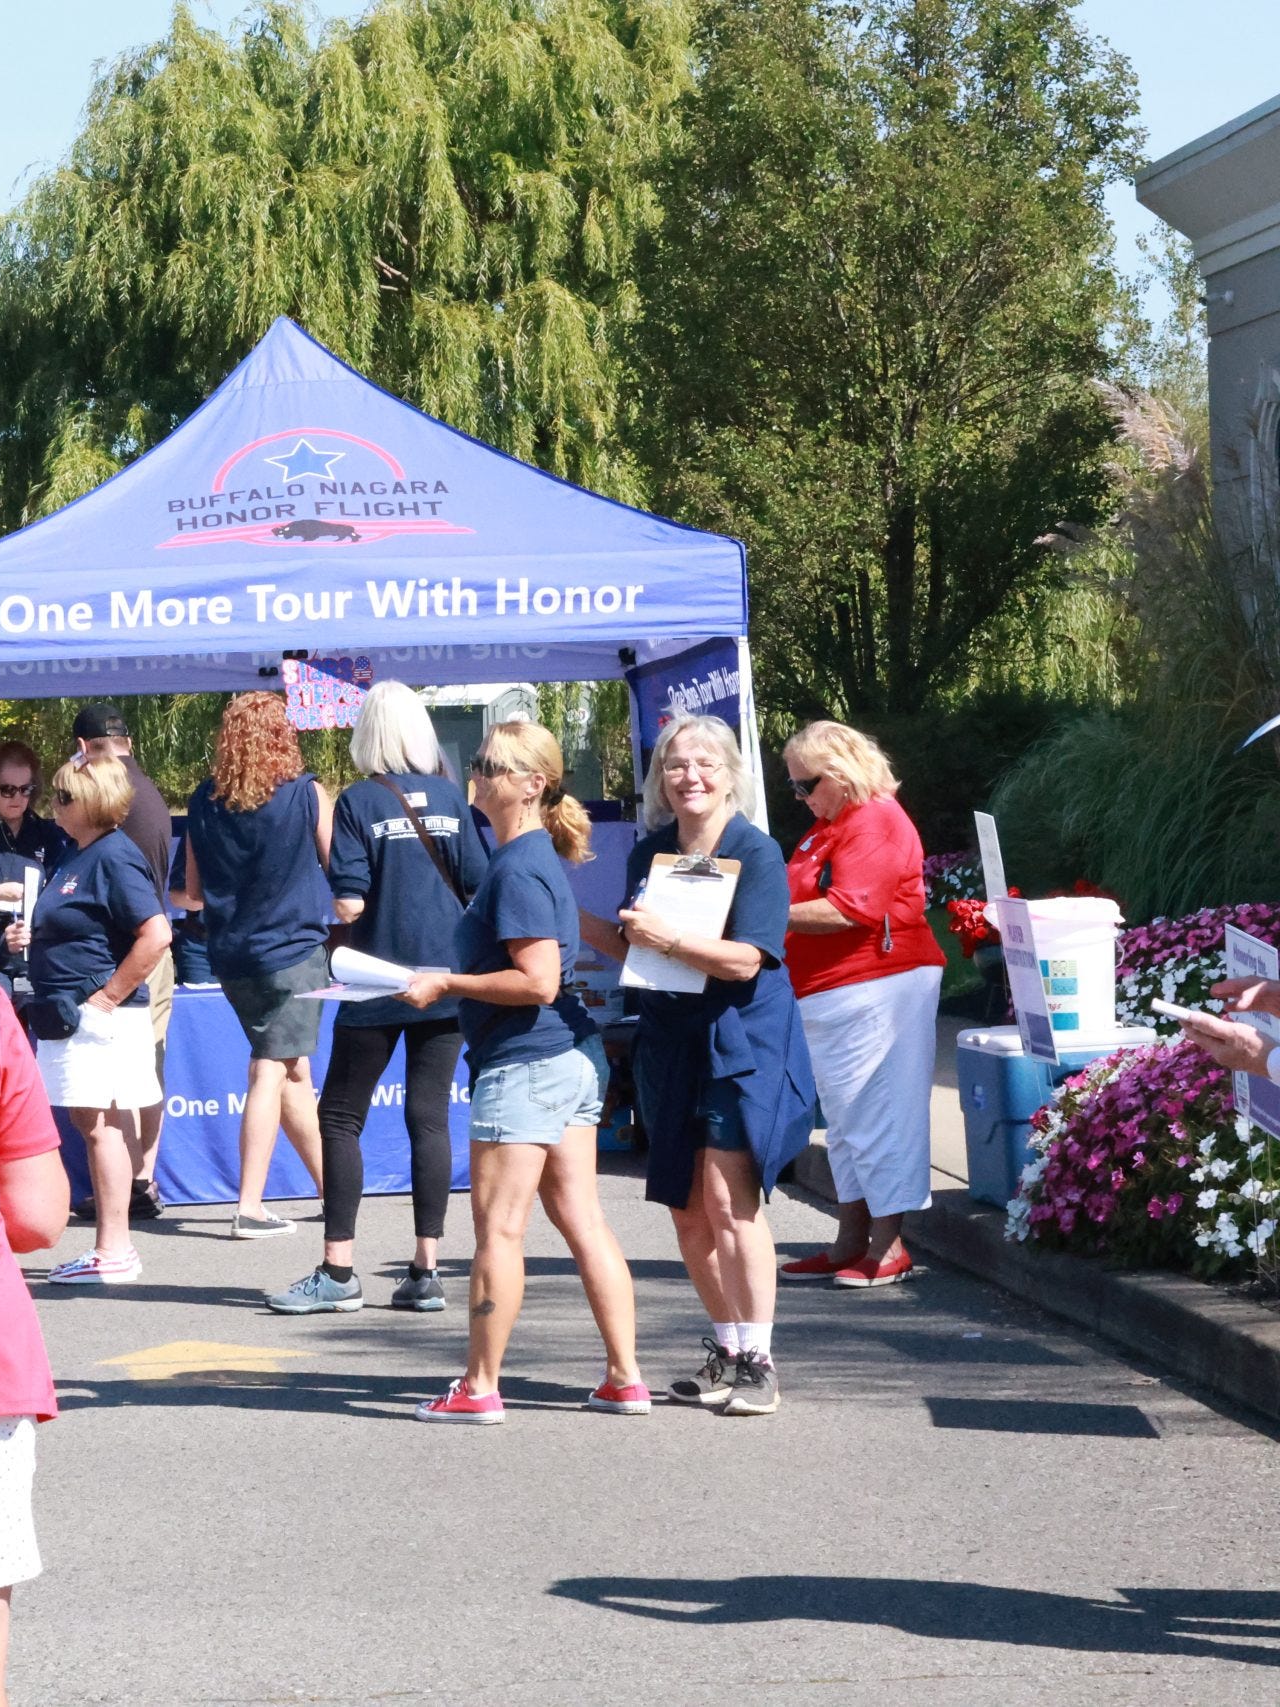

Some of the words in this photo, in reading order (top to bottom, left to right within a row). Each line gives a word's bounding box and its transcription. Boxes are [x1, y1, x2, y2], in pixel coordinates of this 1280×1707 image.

[168, 484, 305, 513] BUFFALO
[320, 480, 450, 496] NIAGARA
[177, 504, 296, 531] HONOR
[315, 501, 442, 517] FLIGHT
[0, 594, 93, 633] One
[110, 590, 232, 629] More
[246, 584, 352, 622] Tour
[366, 577, 478, 618] With
[496, 577, 644, 616] Honor
[285, 703, 361, 730] FOREVE
[166, 1095, 220, 1118] One
